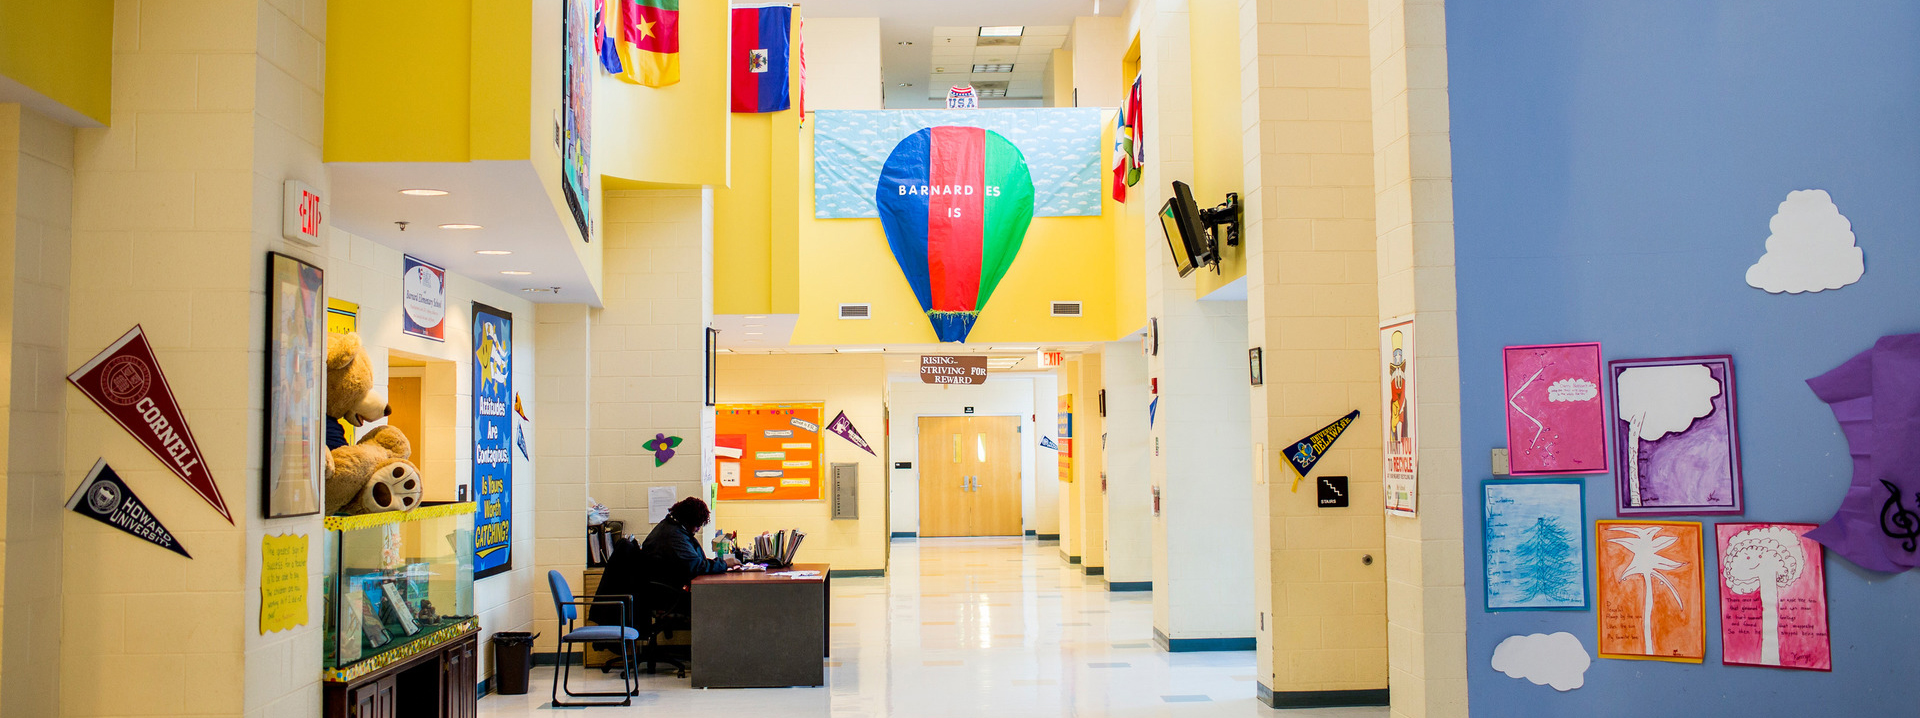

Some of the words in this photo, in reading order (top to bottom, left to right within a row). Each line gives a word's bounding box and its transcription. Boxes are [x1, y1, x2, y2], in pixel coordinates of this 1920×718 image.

[899, 185, 973, 196] BARNARD
[986, 186, 1001, 197] ES
[302, 190, 319, 238] EXIT
[948, 207, 961, 218] IS
[1043, 352, 1061, 366] EXIT
[920, 366, 965, 375] STRIVING
[971, 367, 987, 376] FOR
[934, 376, 972, 384] REWARD
[479, 395, 506, 417] Attitudes
[136, 397, 198, 477] CORNELL
[487, 421, 498, 440] Are
[1309, 421, 1339, 444] UNIVERSITY
[1312, 417, 1352, 455] DELAWARE
[1401, 437, 1412, 455] YOU
[1393, 456, 1413, 473] RECYCLE
[481, 475, 488, 495] Is
[488, 475, 504, 495] Yours
[484, 498, 501, 519] Worth
[109, 508, 171, 547] UNIVERSITY
[121, 496, 172, 542] HOWARD
[475, 520, 509, 549] CATCHING?
